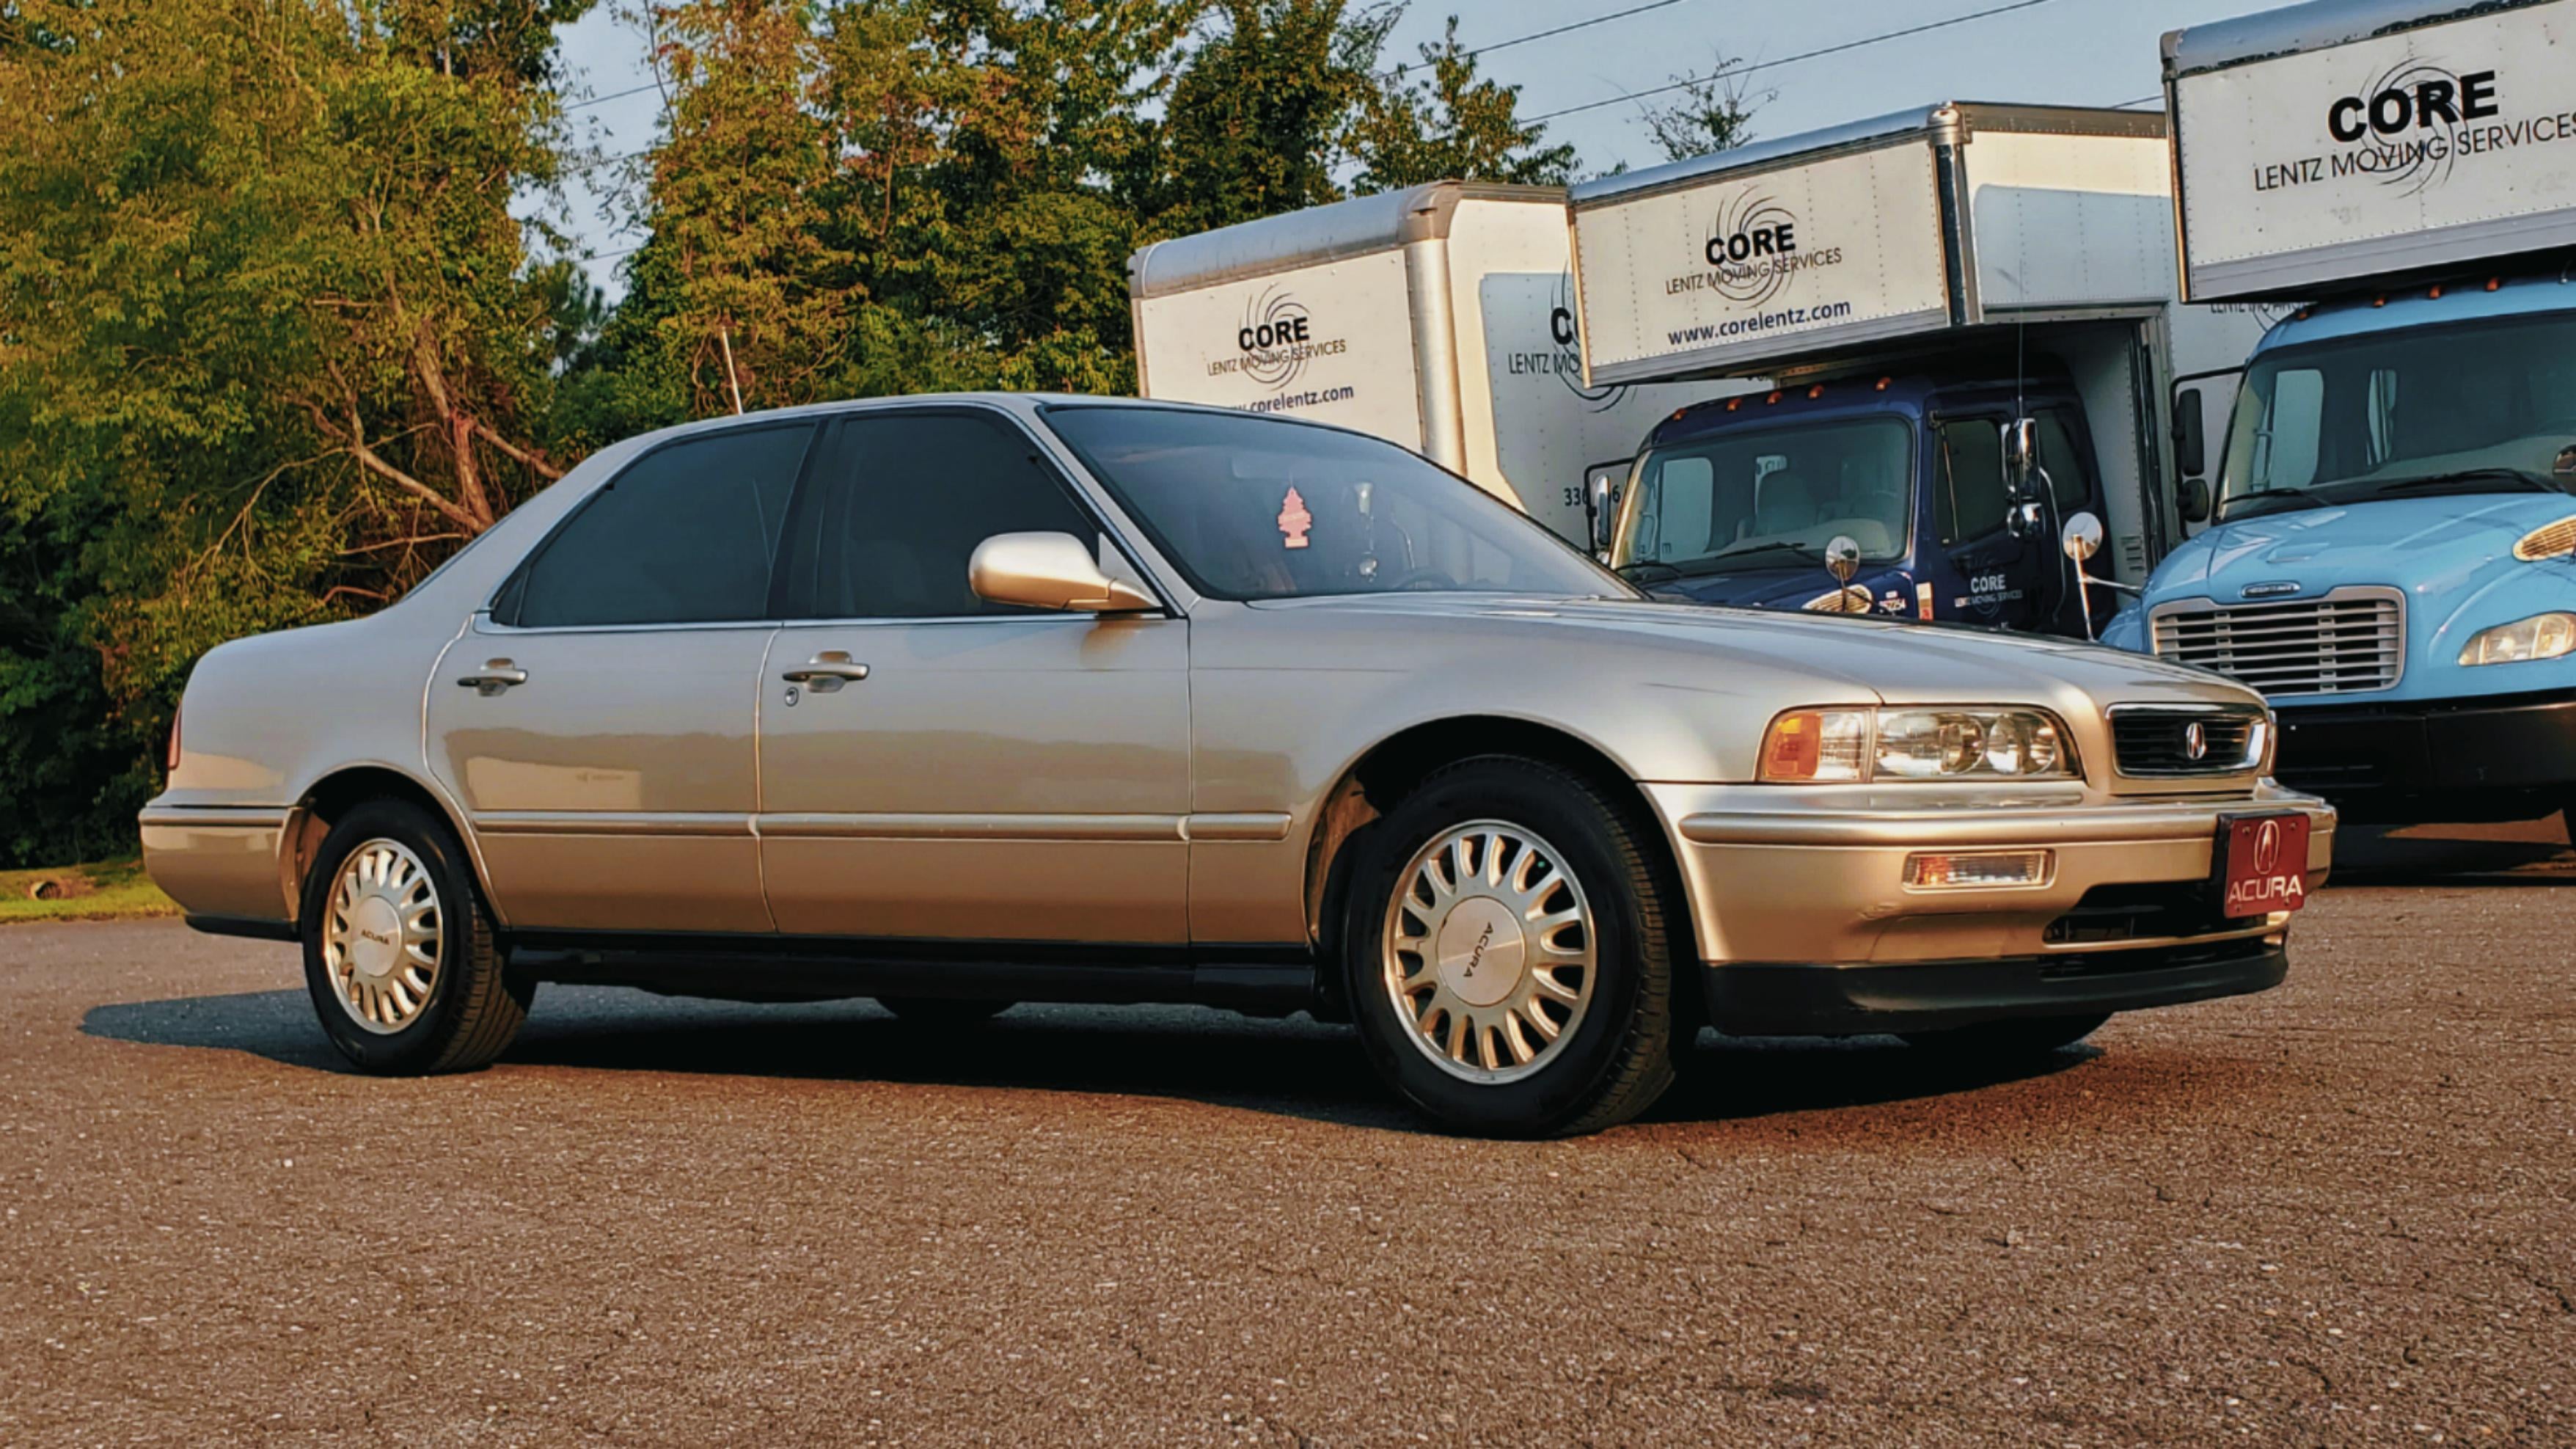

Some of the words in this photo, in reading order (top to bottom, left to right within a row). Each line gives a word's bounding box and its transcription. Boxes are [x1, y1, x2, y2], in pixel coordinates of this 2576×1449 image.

[2329, 70, 2498, 142] CORE
[2254, 157, 2324, 191] LENTZ
[2331, 135, 2448, 178] MOVING
[1705, 223, 1796, 266] CORE
[1666, 274, 1704, 295] LENTZ
[1707, 261, 1771, 286] MOVING
[1773, 247, 1842, 274] SERVICES
[1238, 316, 1310, 352] CORE
[1668, 302, 1851, 346] www.corelentz.com
[1207, 358, 1237, 376] LENTZ
[1240, 348, 1289, 370] MOVING
[1292, 339, 1346, 361] SERVICES
[1508, 353, 1550, 374] LENTZ
[1231, 386, 1354, 412] wcorelentz.com
[1970, 574, 2006, 593] CORE
[2227, 875, 2303, 904] ACURA
[361, 929, 390, 945] ACURA
[1463, 921, 1493, 977] ACURA
